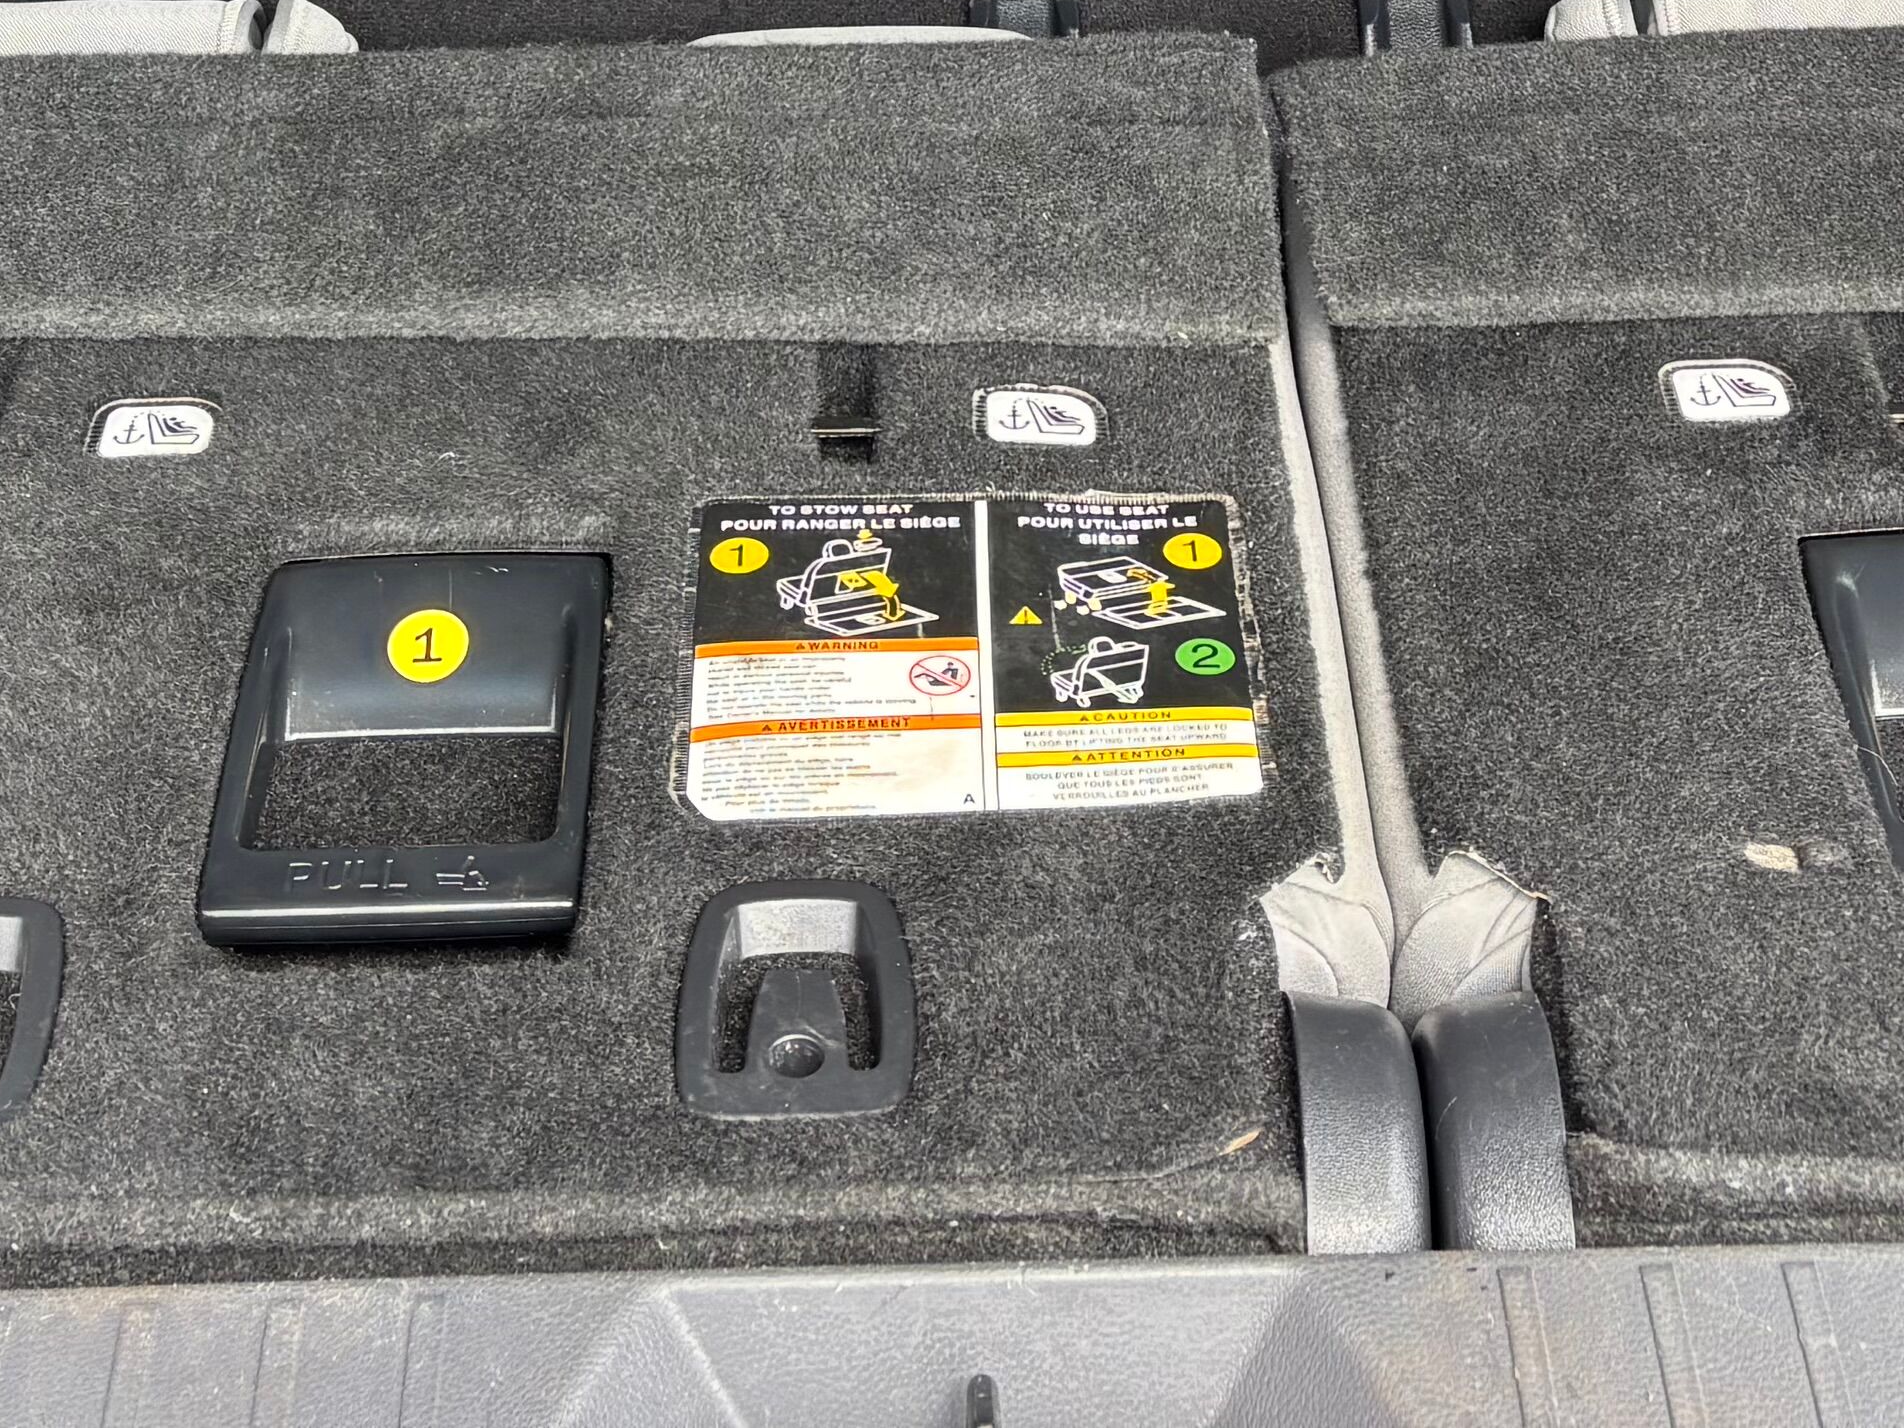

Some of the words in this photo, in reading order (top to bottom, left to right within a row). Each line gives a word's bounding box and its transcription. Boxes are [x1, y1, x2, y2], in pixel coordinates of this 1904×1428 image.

[768, 505, 796, 516] TO
[800, 504, 858, 516] STOW
[862, 503, 914, 515] SEAT
[1044, 502, 1072, 514] TO
[1075, 503, 1115, 515] USE
[1118, 504, 1170, 516] SEAT
[720, 519, 777, 532] POUR
[781, 518, 866, 531] RANGER
[871, 517, 896, 529] LE
[900, 515, 962, 529] SIÈGE
[1017, 516, 1074, 528] POUR
[1078, 517, 1168, 530] UTILISER
[1172, 515, 1198, 527] LE
[1078, 531, 1139, 545] SIÈGE
[729, 544, 744, 567] 1
[1182, 539, 1198, 563] 1
[412, 628, 443, 663] 1
[809, 641, 879, 650] WARNING
[1191, 643, 1221, 669] 2
[1094, 711, 1172, 722] CAUTION
[777, 717, 911, 732] AVERTISSEMENT
[1087, 747, 1186, 762] ATTENTION
[963, 794, 976, 805] A
[287, 858, 409, 893] PULL
